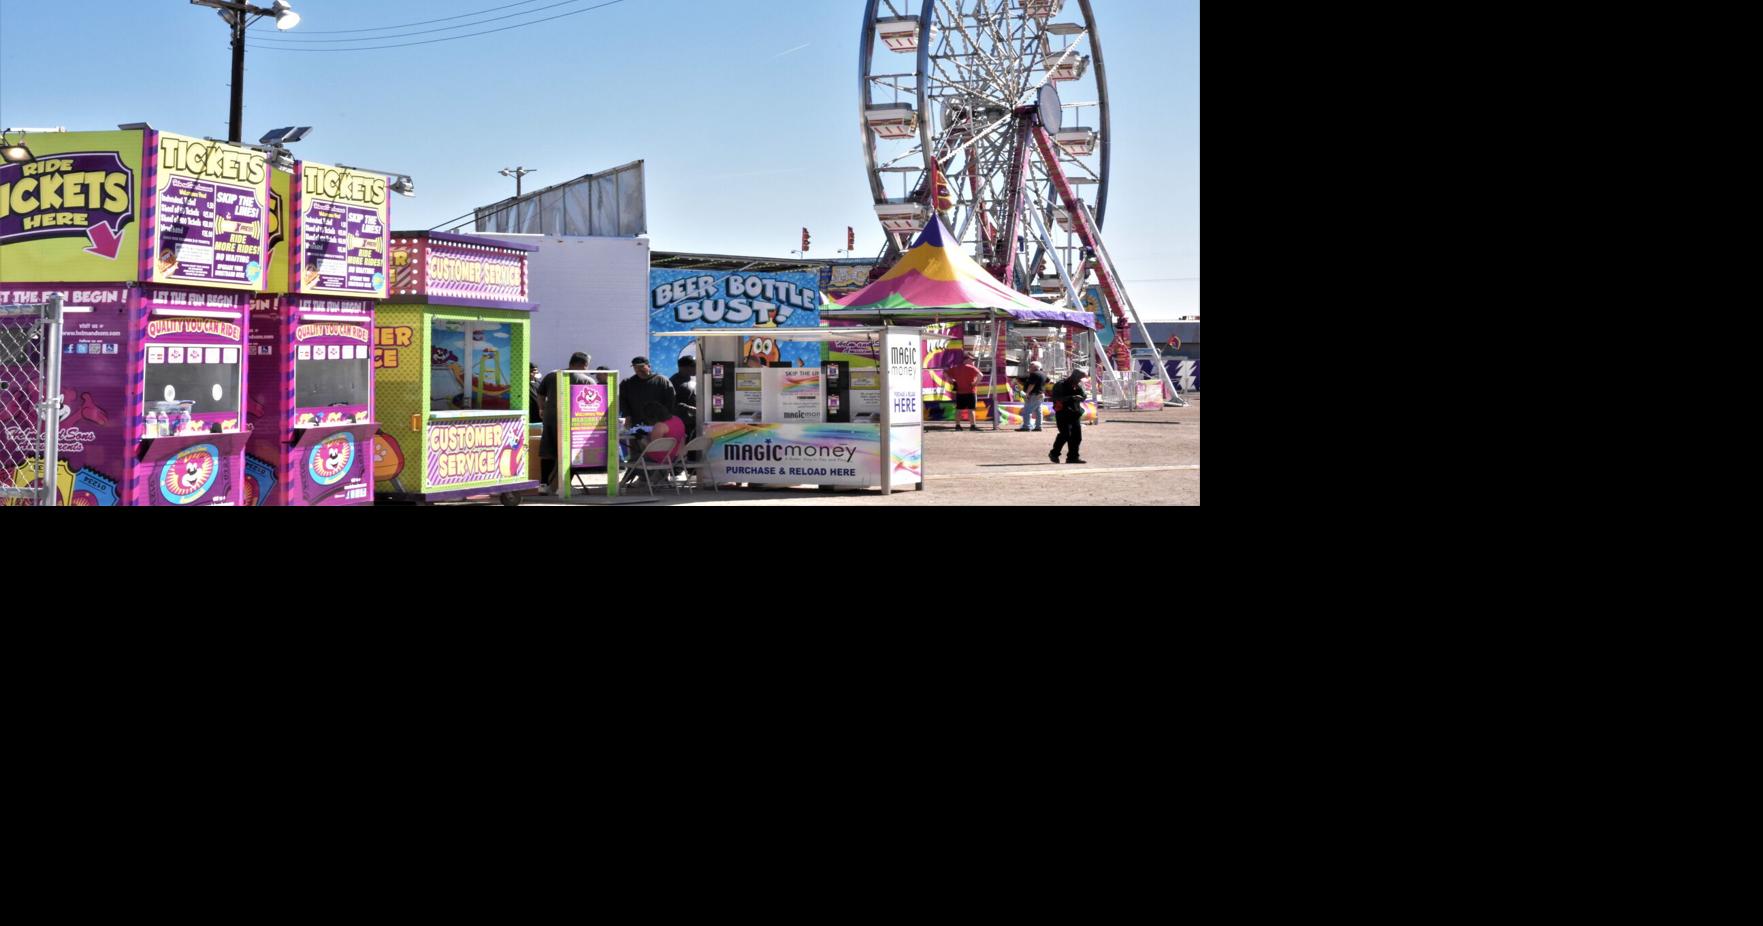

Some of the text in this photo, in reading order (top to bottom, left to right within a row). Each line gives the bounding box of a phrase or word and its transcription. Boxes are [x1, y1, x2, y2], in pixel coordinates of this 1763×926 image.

[22, 159, 74, 176] RIDE
[161, 137, 265, 184] TICKETS
[304, 166, 386, 205] TICKETS
[216, 192, 237, 204] SKIP
[239, 195, 255, 207] THE
[234, 205, 259, 218] LINES!
[23, 212, 88, 230] HERE
[230, 233, 247, 244] RIDE
[215, 241, 260, 255] MORE RIDES!
[215, 253, 225, 261] NO
[430, 256, 521, 287] CUSTOMER SERVICE
[0, 291, 10, 303] T
[13, 291, 38, 303] THE
[42, 291, 69, 302] FN
[152, 290, 169, 304] LET
[170, 291, 187, 305] THE
[188, 292, 205, 306] FUN
[652, 274, 718, 309] BEER
[725, 272, 816, 311] BOTTLE
[675, 297, 795, 325] BUST!
[148, 318, 240, 341] QUALITY YOU CAN RIDE!
[296, 323, 323, 342] QUALITY
[374, 326, 414, 347] ER
[891, 341, 917, 365] MAGIC
[891, 366, 917, 380] money
[894, 398, 916, 413] HERE
[65, 426, 96, 442] Sons
[430, 422, 503, 453] CUSTOMER
[438, 449, 497, 479] SERVICE
[725, 466, 856, 476] PURCHASE & RELOAD HERE
